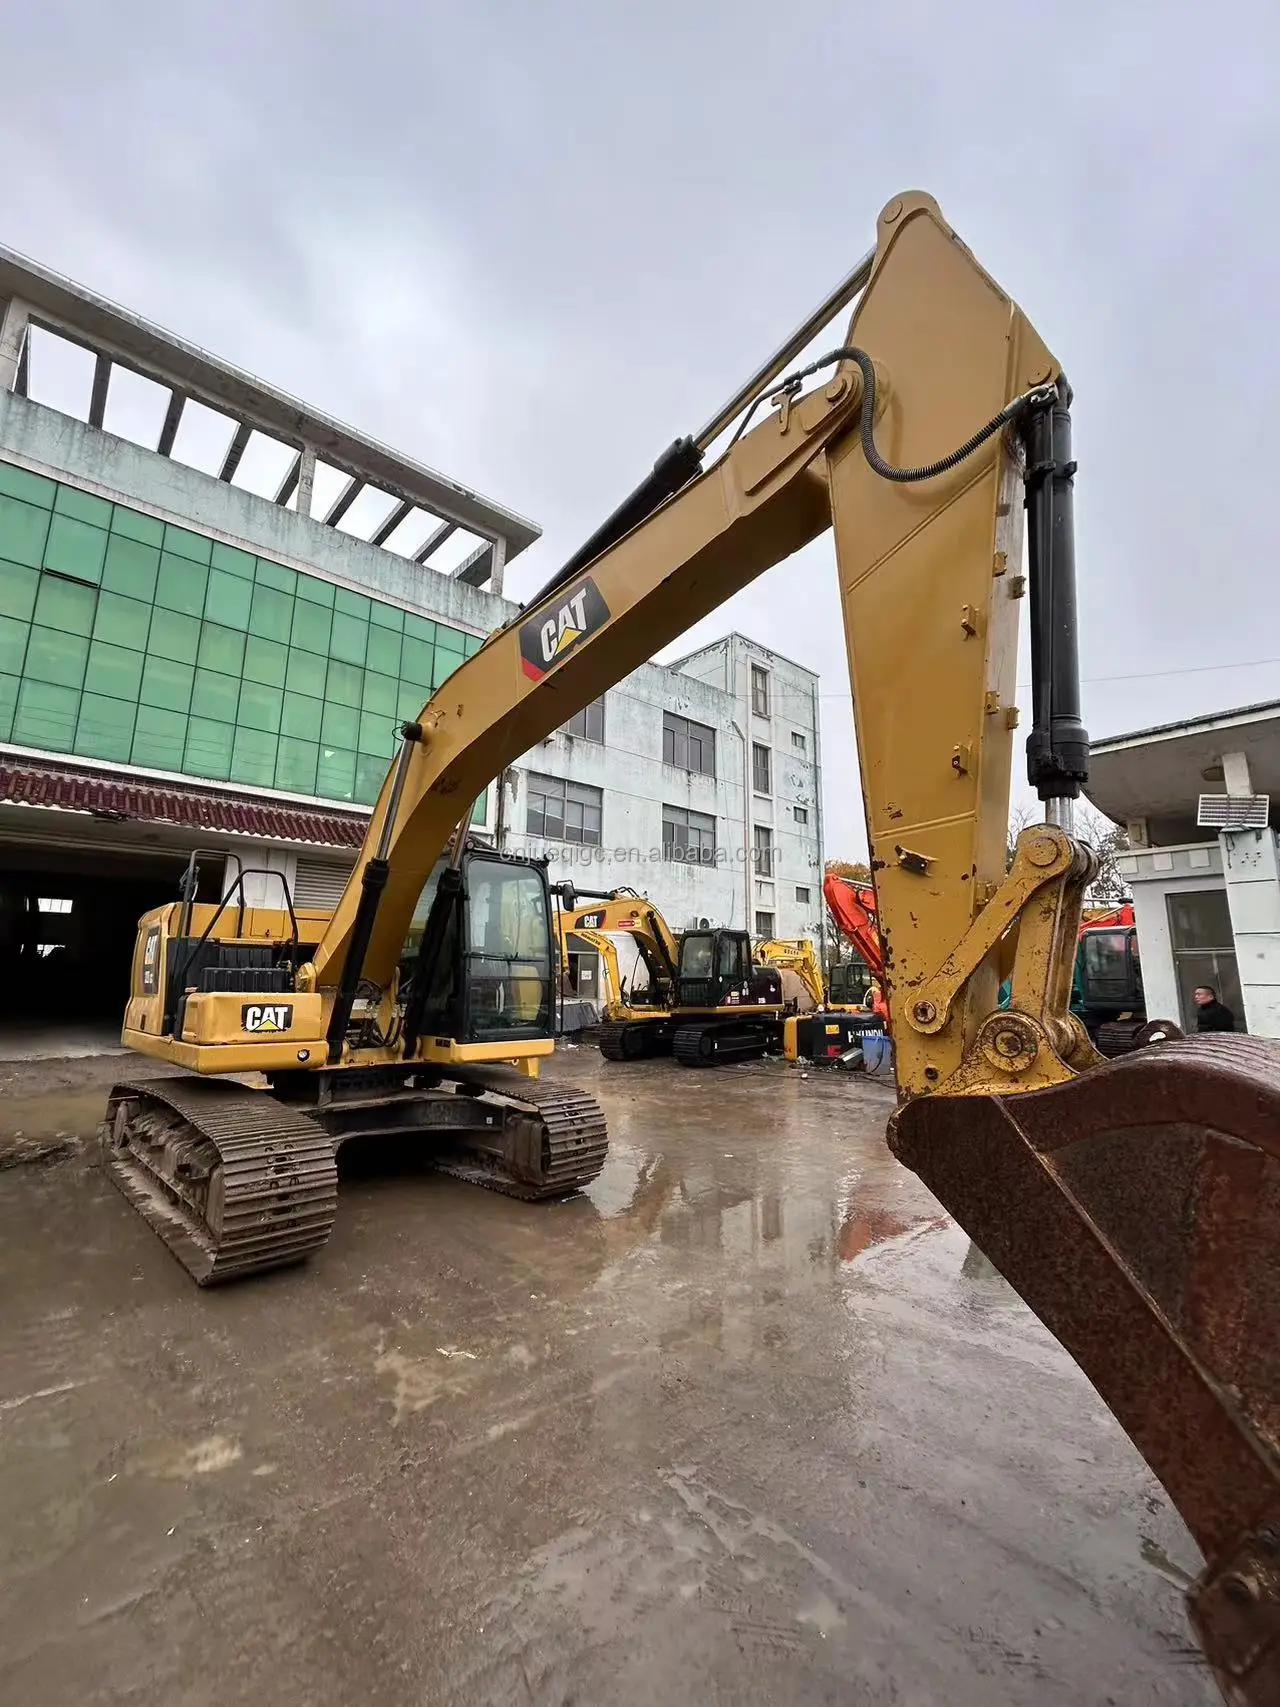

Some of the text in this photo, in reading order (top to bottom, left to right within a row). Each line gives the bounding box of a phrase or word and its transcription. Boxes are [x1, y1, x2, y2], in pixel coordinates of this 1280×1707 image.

[541, 588, 587, 662] CAT
[584, 915, 598, 928] CAT
[246, 1006, 288, 1031] CAT
